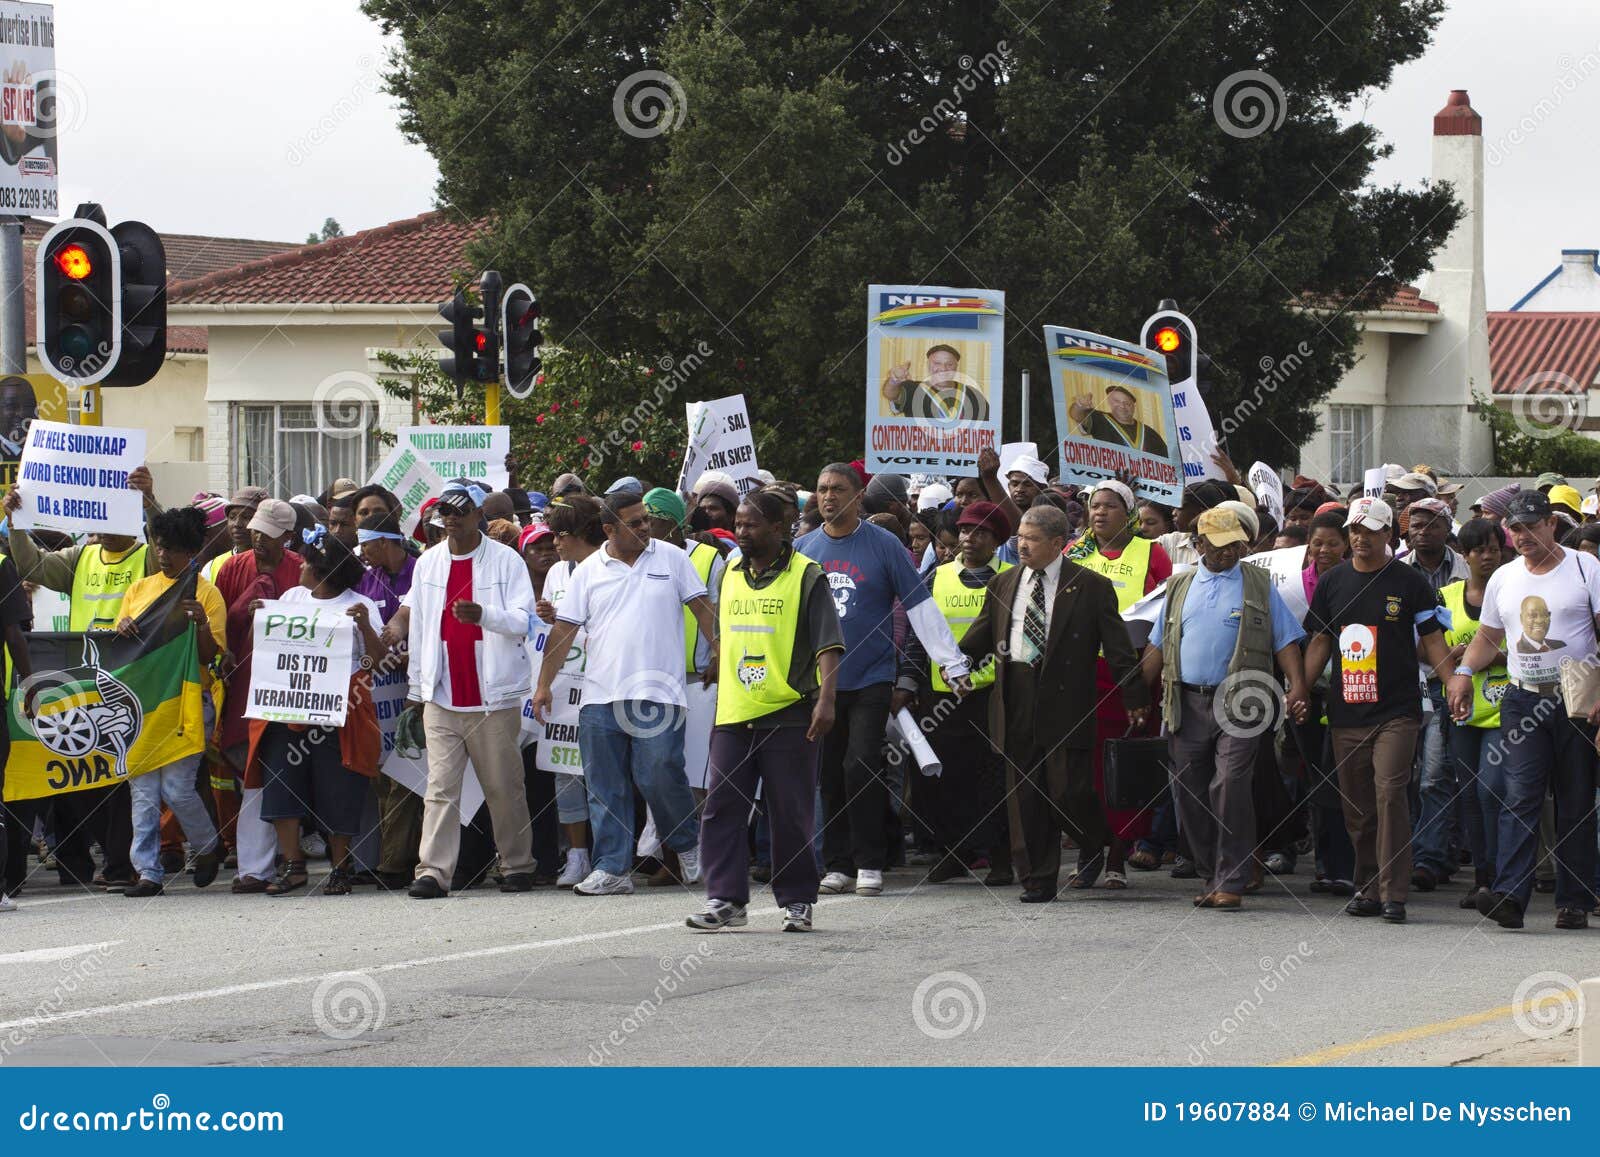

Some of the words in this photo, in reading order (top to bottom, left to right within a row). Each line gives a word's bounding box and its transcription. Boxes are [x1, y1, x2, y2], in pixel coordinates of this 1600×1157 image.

[31, 15, 39, 46] in
[40, 16, 54, 49] this
[3, 87, 36, 123] SPACE
[0, 187, 17, 208] 083
[19, 188, 40, 209] 2299
[42, 190, 58, 210] 543
[888, 295, 961, 307] NPP
[1064, 335, 1130, 356] NPP
[83, 391, 91, 412] 4
[33, 429, 45, 448] DIE
[45, 431, 66, 452] HELE
[68, 434, 127, 456] SUIDKAAP
[448, 433, 493, 449] AGAINST
[872, 425, 941, 452] CONTROVERSIAL
[942, 427, 955, 453] but
[957, 428, 995, 454] DELIVERS
[1179, 426, 1191, 441] IS
[728, 445, 752, 466] SKEP
[877, 456, 939, 466] VOTE
[945, 458, 976, 467] NP
[1064, 440, 1127, 472] CONTROVERSIAL
[1129, 454, 1142, 477] but
[1142, 458, 1178, 485] DELIVERS
[23, 461, 51, 482] WORD
[54, 465, 96, 488] GEKNOU
[99, 470, 129, 489] DEUR
[459, 463, 466, 477] &
[469, 461, 487, 477] HIS
[1071, 468, 1117, 481] VOT
[38, 496, 51, 514] DA
[53, 500, 61, 516] &
[63, 498, 108, 520] BREDELL
[729, 598, 784, 616] VOLUNTEER
[945, 594, 984, 608] VOLUNT
[276, 653, 299, 670] DIS
[303, 655, 328, 673] TYD
[289, 673, 312, 690] VIR
[1343, 673, 1376, 684] SAFER
[254, 688, 344, 712] VERANDERING
[1343, 692, 1377, 701] SEASON
[545, 722, 579, 744] VERA
